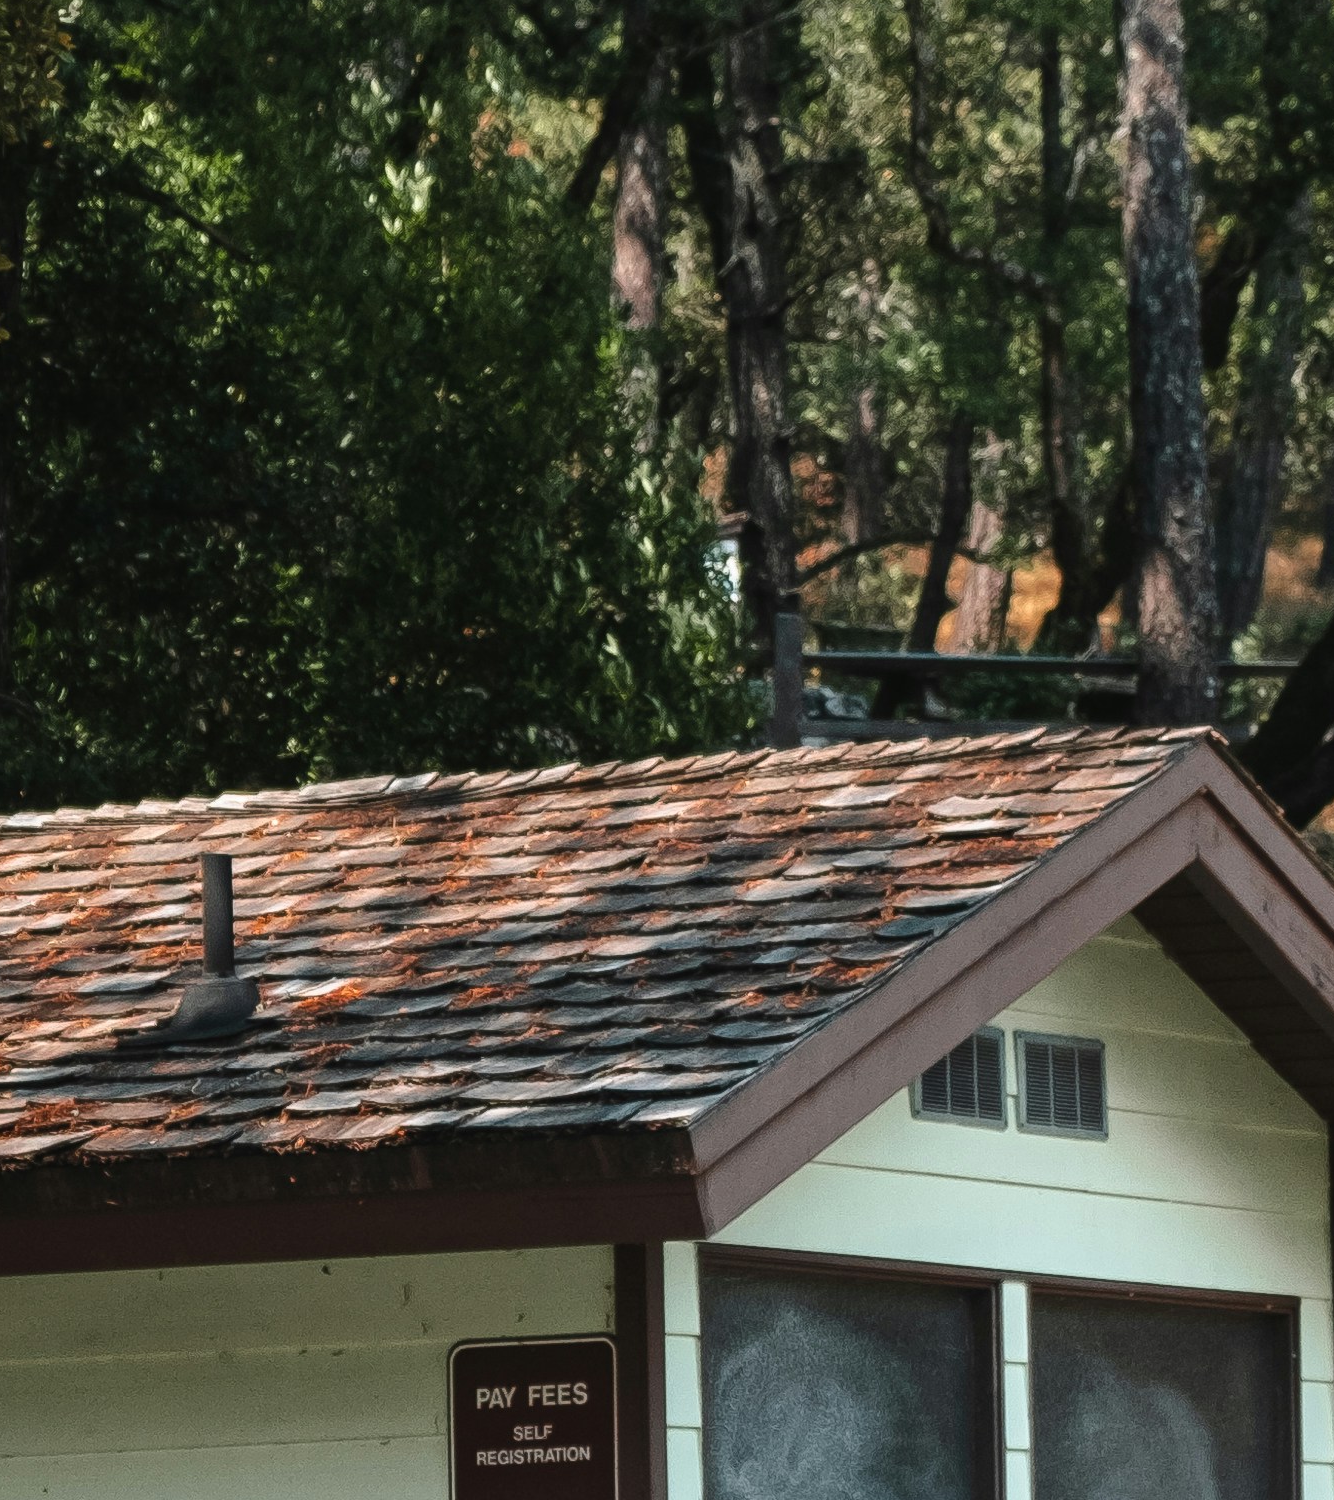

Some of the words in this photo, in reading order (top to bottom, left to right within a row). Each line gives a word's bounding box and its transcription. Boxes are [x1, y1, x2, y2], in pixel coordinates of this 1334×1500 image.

[476, 1386, 517, 1409] PAY
[528, 1382, 588, 1407] FEES
[513, 1424, 553, 1441] SELF
[476, 1446, 591, 1466] REGISTRATION
